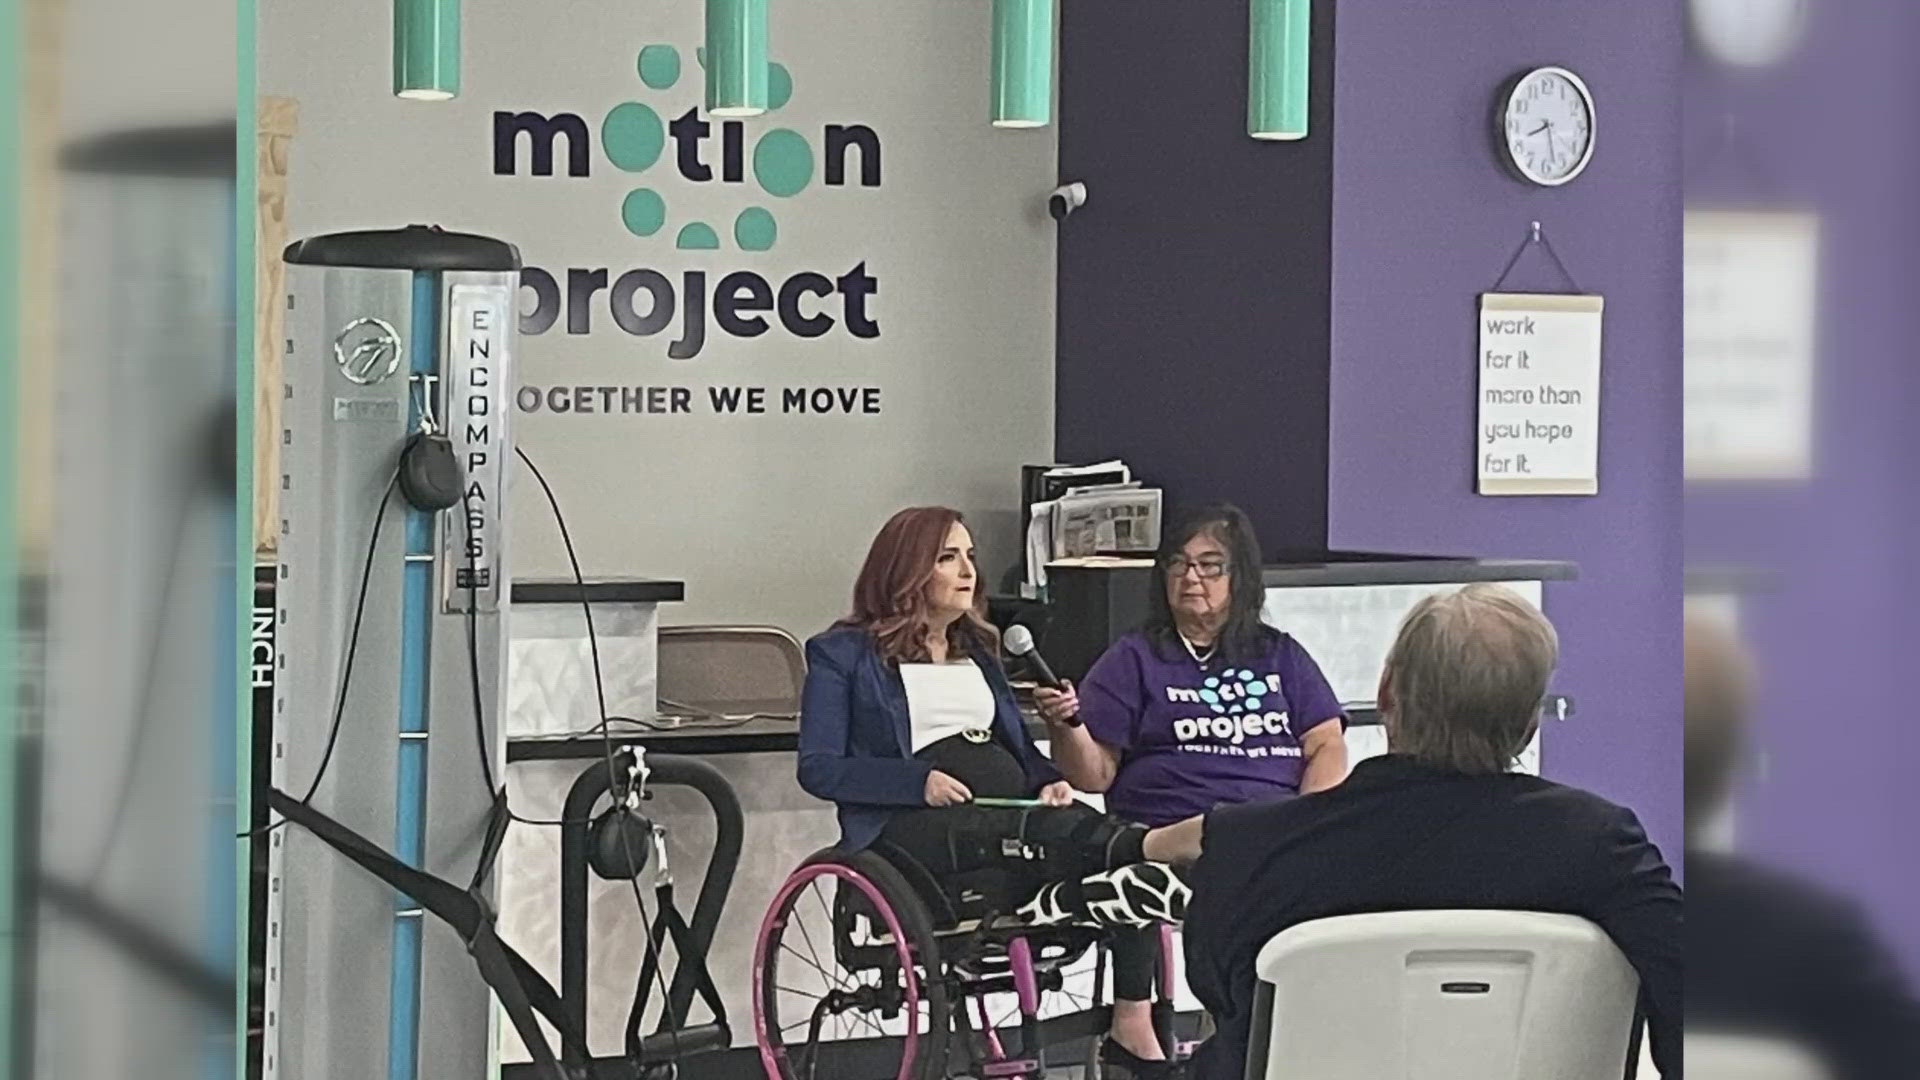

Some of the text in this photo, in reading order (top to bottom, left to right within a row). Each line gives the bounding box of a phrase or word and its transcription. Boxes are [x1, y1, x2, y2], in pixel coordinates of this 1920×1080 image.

[494, 101, 881, 197] motion
[1487, 316, 1535, 335] work
[1486, 350, 1530, 370] for it
[517, 385, 881, 414] OGETHER WE MOVE
[1486, 385, 1582, 405] more than
[465, 310, 491, 558] ENCOMPASS
[1485, 420, 1573, 444] you hope
[1484, 452, 1511, 473] for
[251, 607, 274, 687] INCH
[1173, 711, 1292, 744] project
